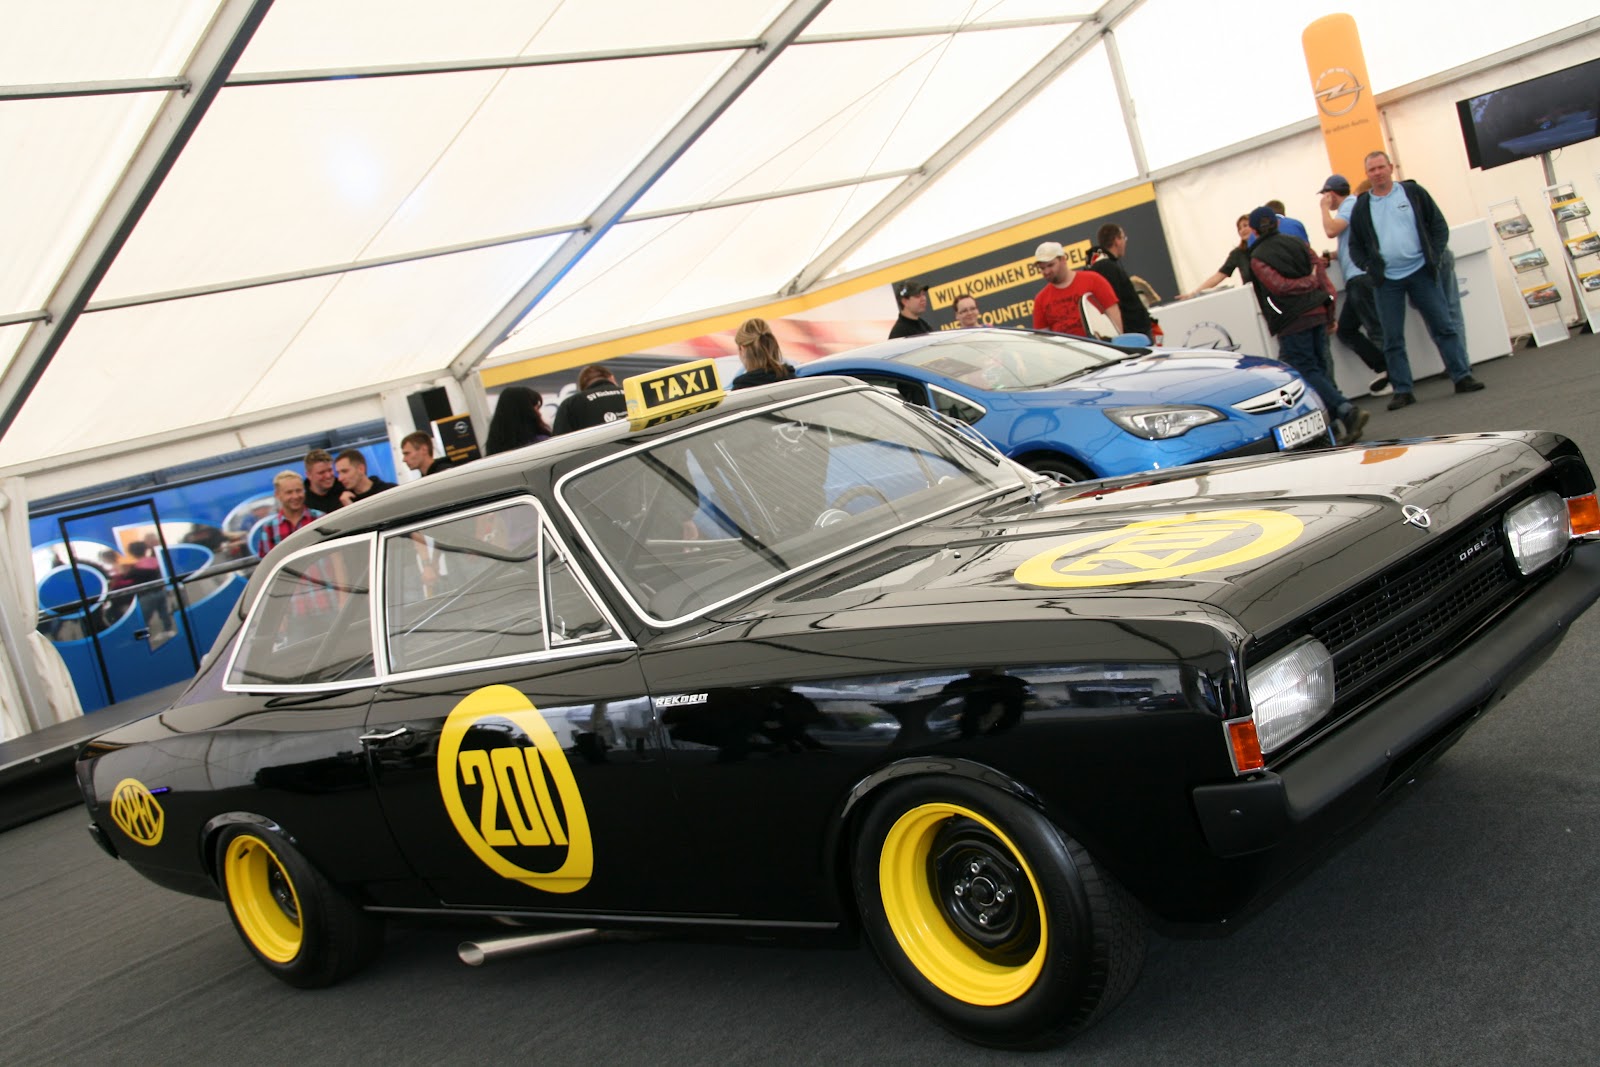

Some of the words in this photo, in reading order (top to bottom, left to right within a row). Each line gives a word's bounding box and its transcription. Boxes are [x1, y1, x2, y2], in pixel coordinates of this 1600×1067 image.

[934, 265, 1025, 304] WILLKOMMEN
[1027, 262, 1042, 277] BE
[649, 369, 710, 402] TAXI
[1459, 540, 1487, 561] OPEL
[655, 693, 709, 708] REKORD
[458, 746, 569, 847] 201
